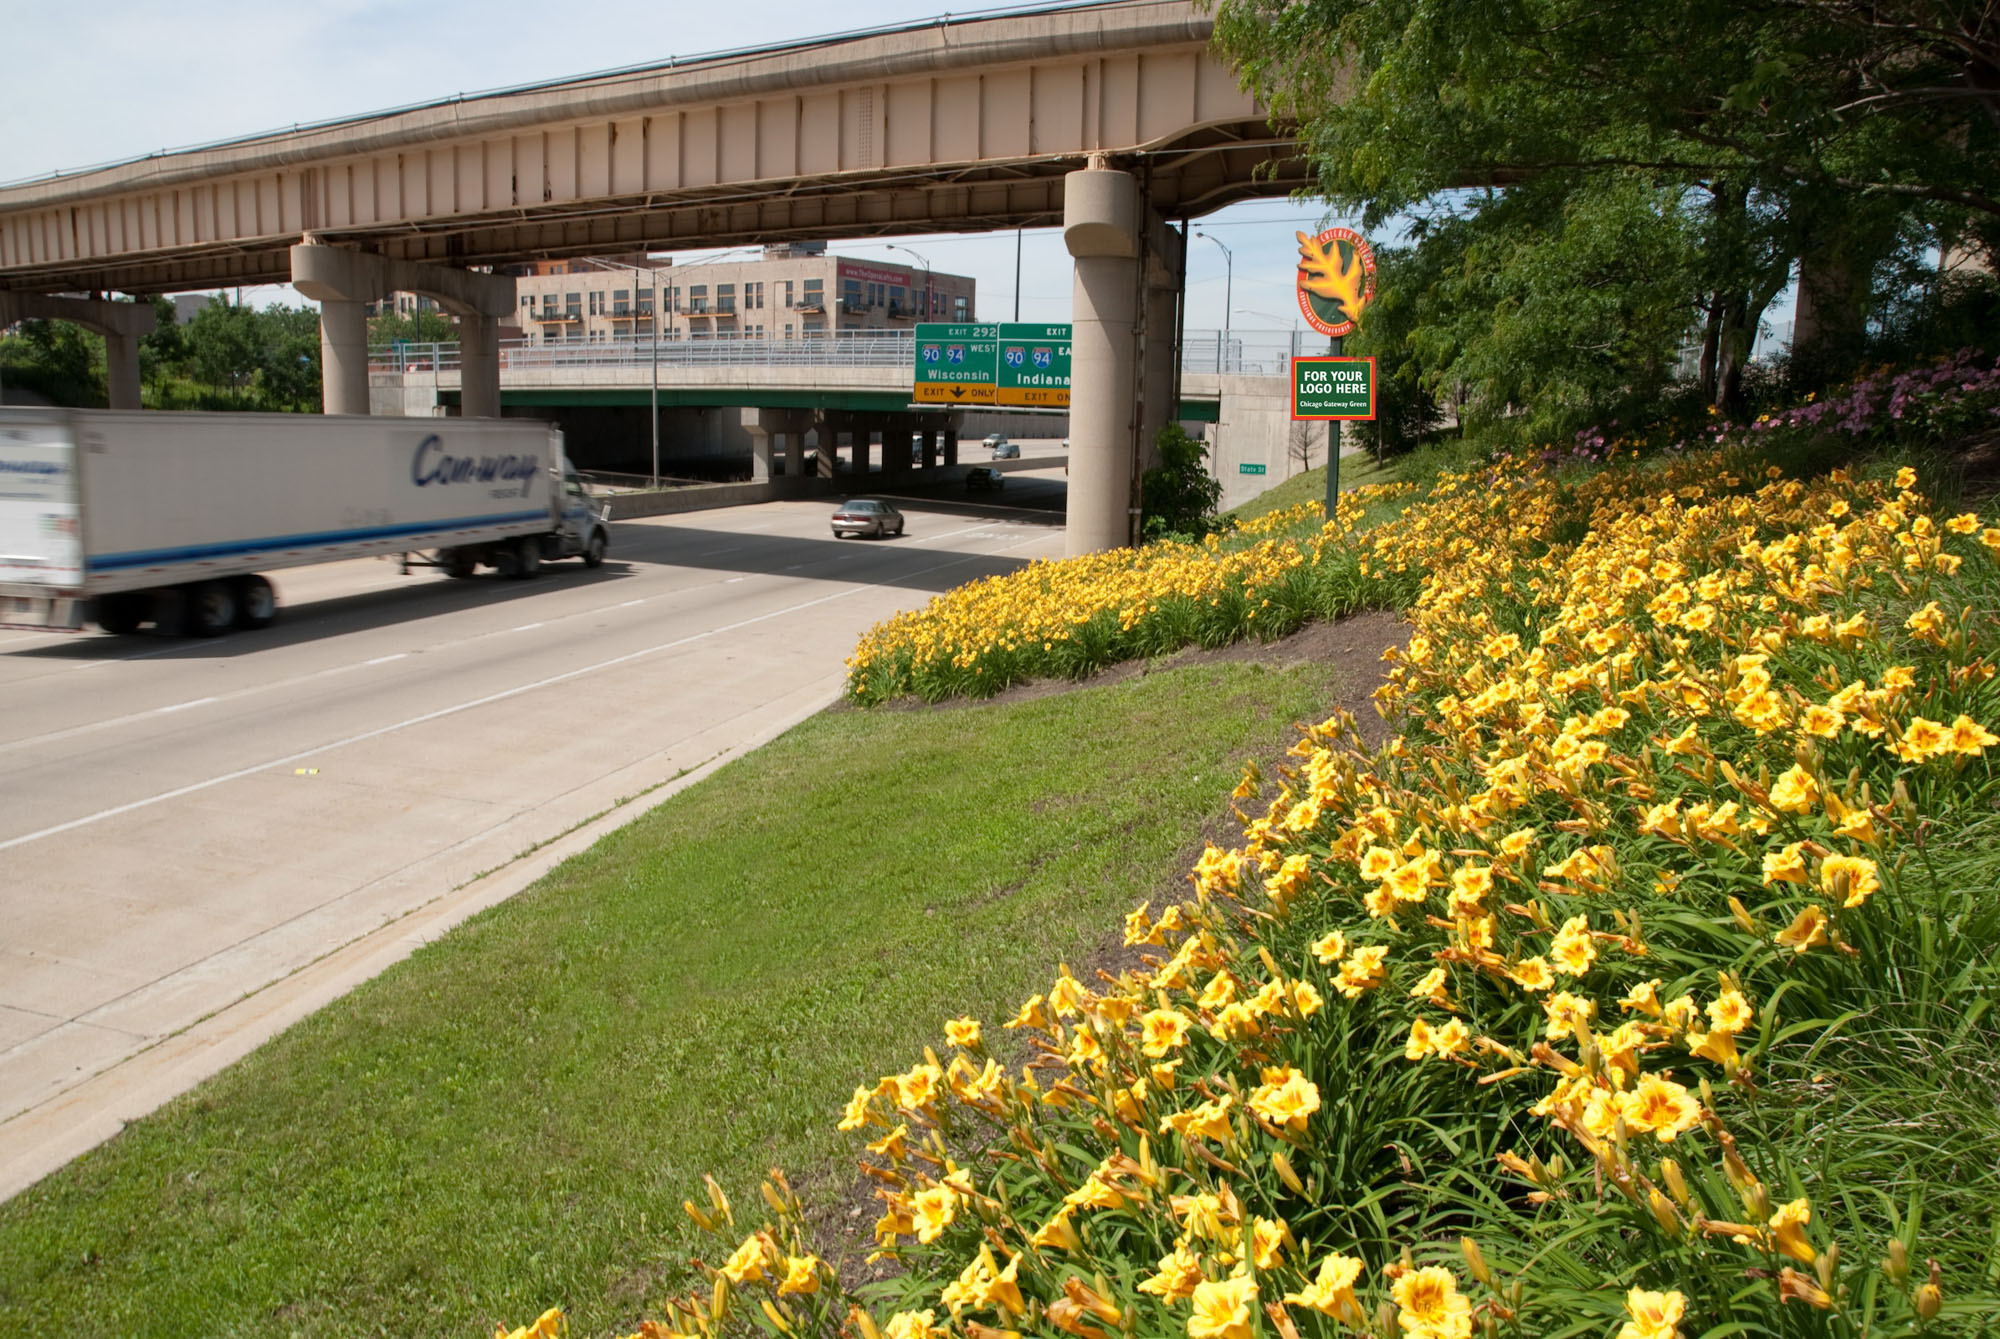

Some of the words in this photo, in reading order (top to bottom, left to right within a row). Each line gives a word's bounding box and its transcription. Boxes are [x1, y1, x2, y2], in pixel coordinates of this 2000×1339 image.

[1319, 228, 1353, 242] CHICAGO
[949, 328, 967, 336] EXIT
[972, 327, 997, 338] 292
[1046, 327, 1067, 336] EXIT
[923, 349, 940, 361] 90
[947, 349, 964, 361] 94
[970, 343, 996, 353] WEST
[1006, 352, 1024, 364] 90
[1033, 352, 1050, 365] 94
[1058, 346, 1072, 356] EA
[927, 369, 990, 381] Wisconsin
[1017, 373, 1071, 386] Indiana
[1304, 371, 1327, 382] FOR
[1331, 371, 1363, 382] YOUR
[923, 388, 945, 397] EXIT
[971, 389, 996, 398] ONLY
[1300, 383, 1332, 394] LOGO
[1336, 383, 1367, 394] HERE
[1024, 392, 1048, 401] EXIT
[1056, 393, 1071, 402] ON
[1300, 400, 1323, 409] Chicago
[1323, 400, 1348, 409] Gateway
[1349, 400, 1367, 408] Green
